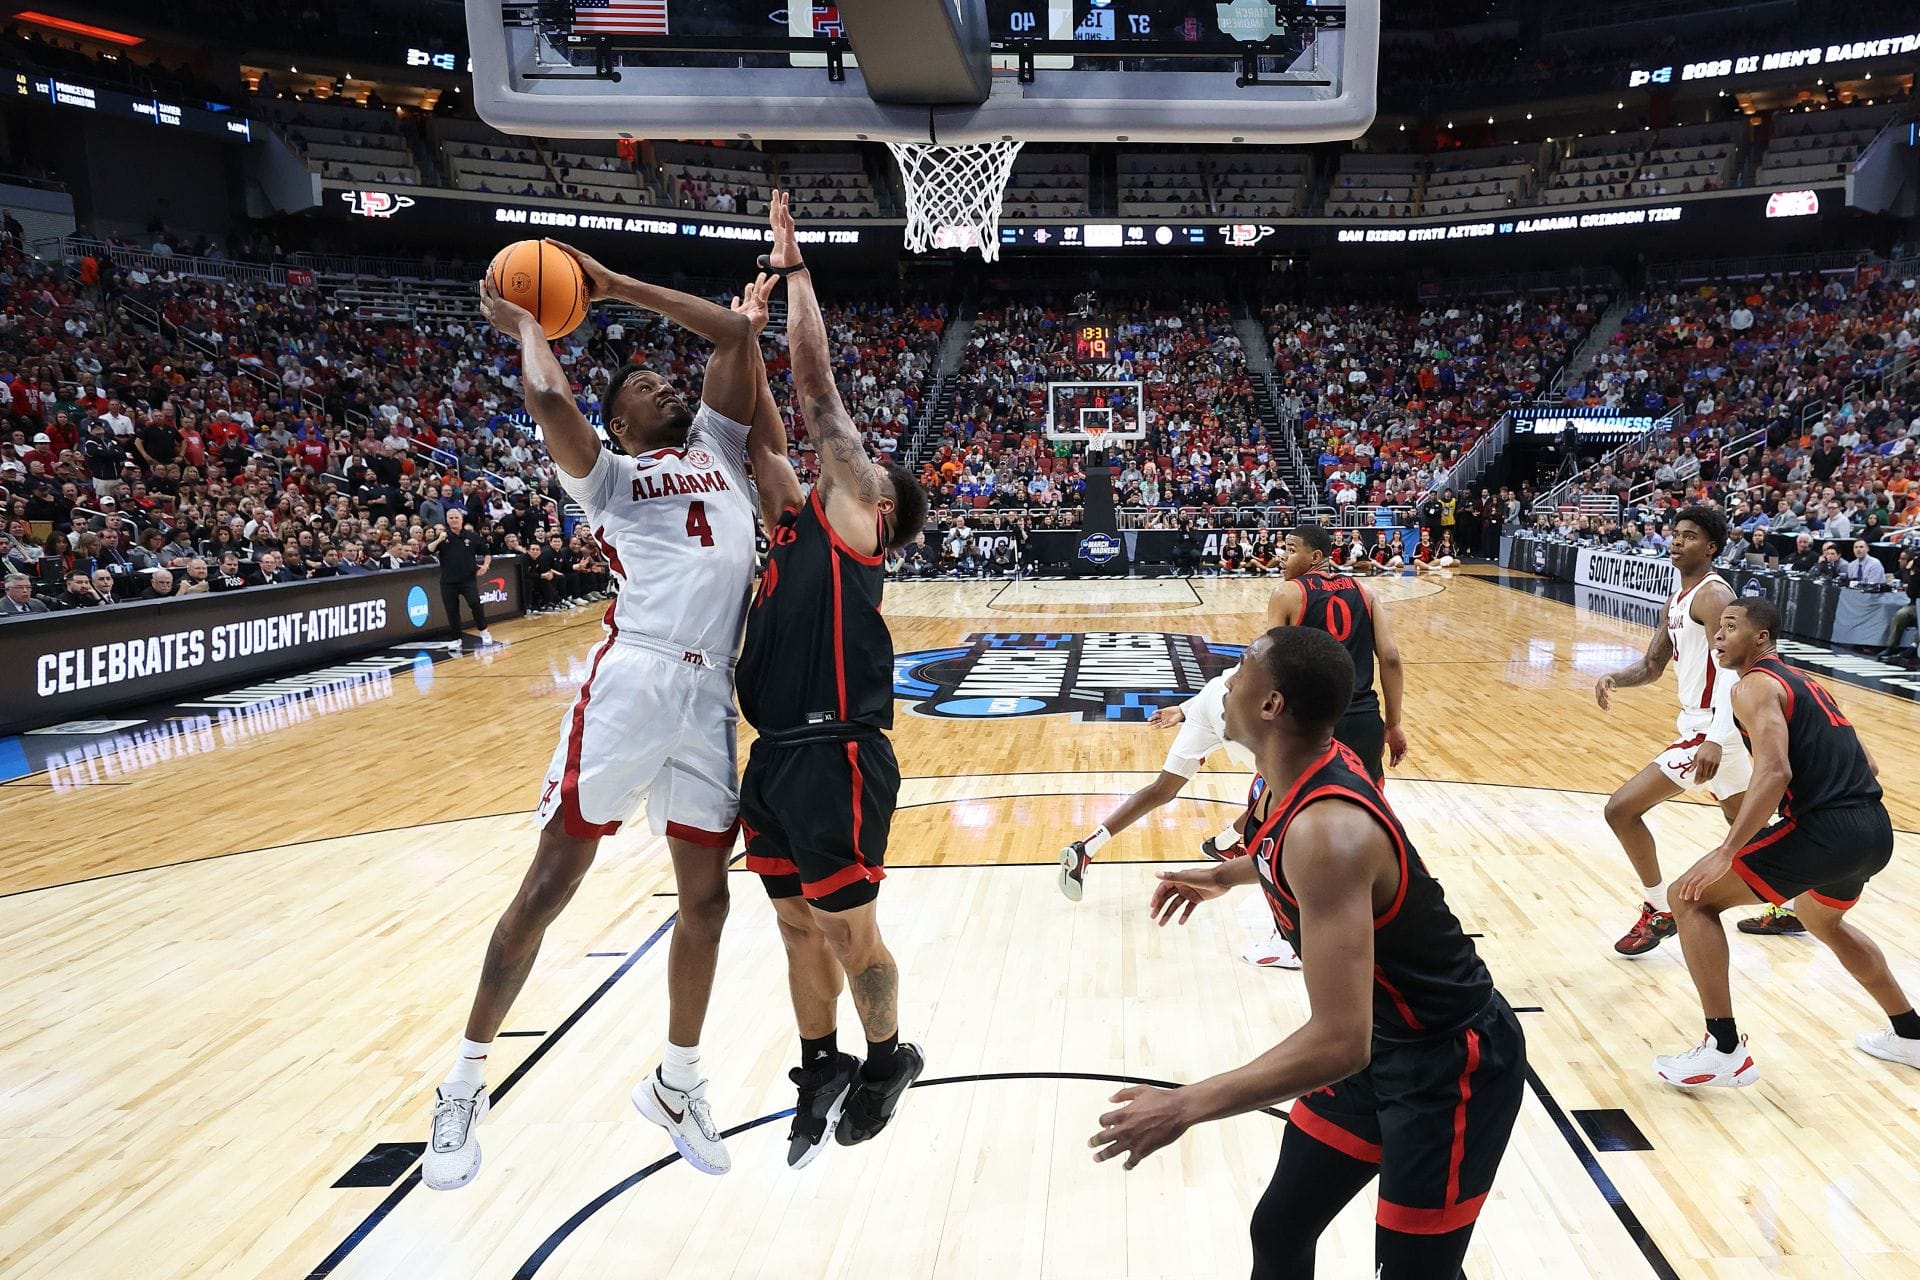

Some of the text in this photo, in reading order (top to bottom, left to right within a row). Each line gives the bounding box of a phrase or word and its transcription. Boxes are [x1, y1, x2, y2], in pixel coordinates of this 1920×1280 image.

[1682, 59, 1732, 81] 2023
[1762, 48, 1822, 71] MEN'S
[496, 208, 527, 223] SAN
[529, 211, 577, 228] DIEGO
[579, 214, 623, 231] STATE
[624, 218, 677, 235] AZTECS
[682, 224, 697, 236] VS
[699, 224, 762, 242] ALABAMA
[828, 230, 860, 243] TIDE
[1337, 229, 1364, 242] SAN
[1366, 229, 1407, 242] DIEGO
[1407, 227, 1447, 242] STATE
[1447, 222, 1495, 239] AZTECS
[1499, 223, 1513, 234] VS
[1515, 215, 1579, 234] ALABAMA
[1647, 206, 1683, 222] TIDE
[1083, 327, 1109, 339] 13:31
[1090, 339, 1106, 358] 19
[1582, 417, 1653, 433] MADNESS
[631, 470, 731, 502] ALABAMA
[685, 500, 715, 547] 4
[1087, 540, 1110, 548] MARCH
[1588, 554, 1621, 587] SOUTH
[1326, 594, 1352, 642] 0
[37, 598, 387, 698] CELEBRATES STUDENT-ATHLETES
[1075, 632, 1180, 689] MADNESS
[952, 649, 1071, 697] MARCH
